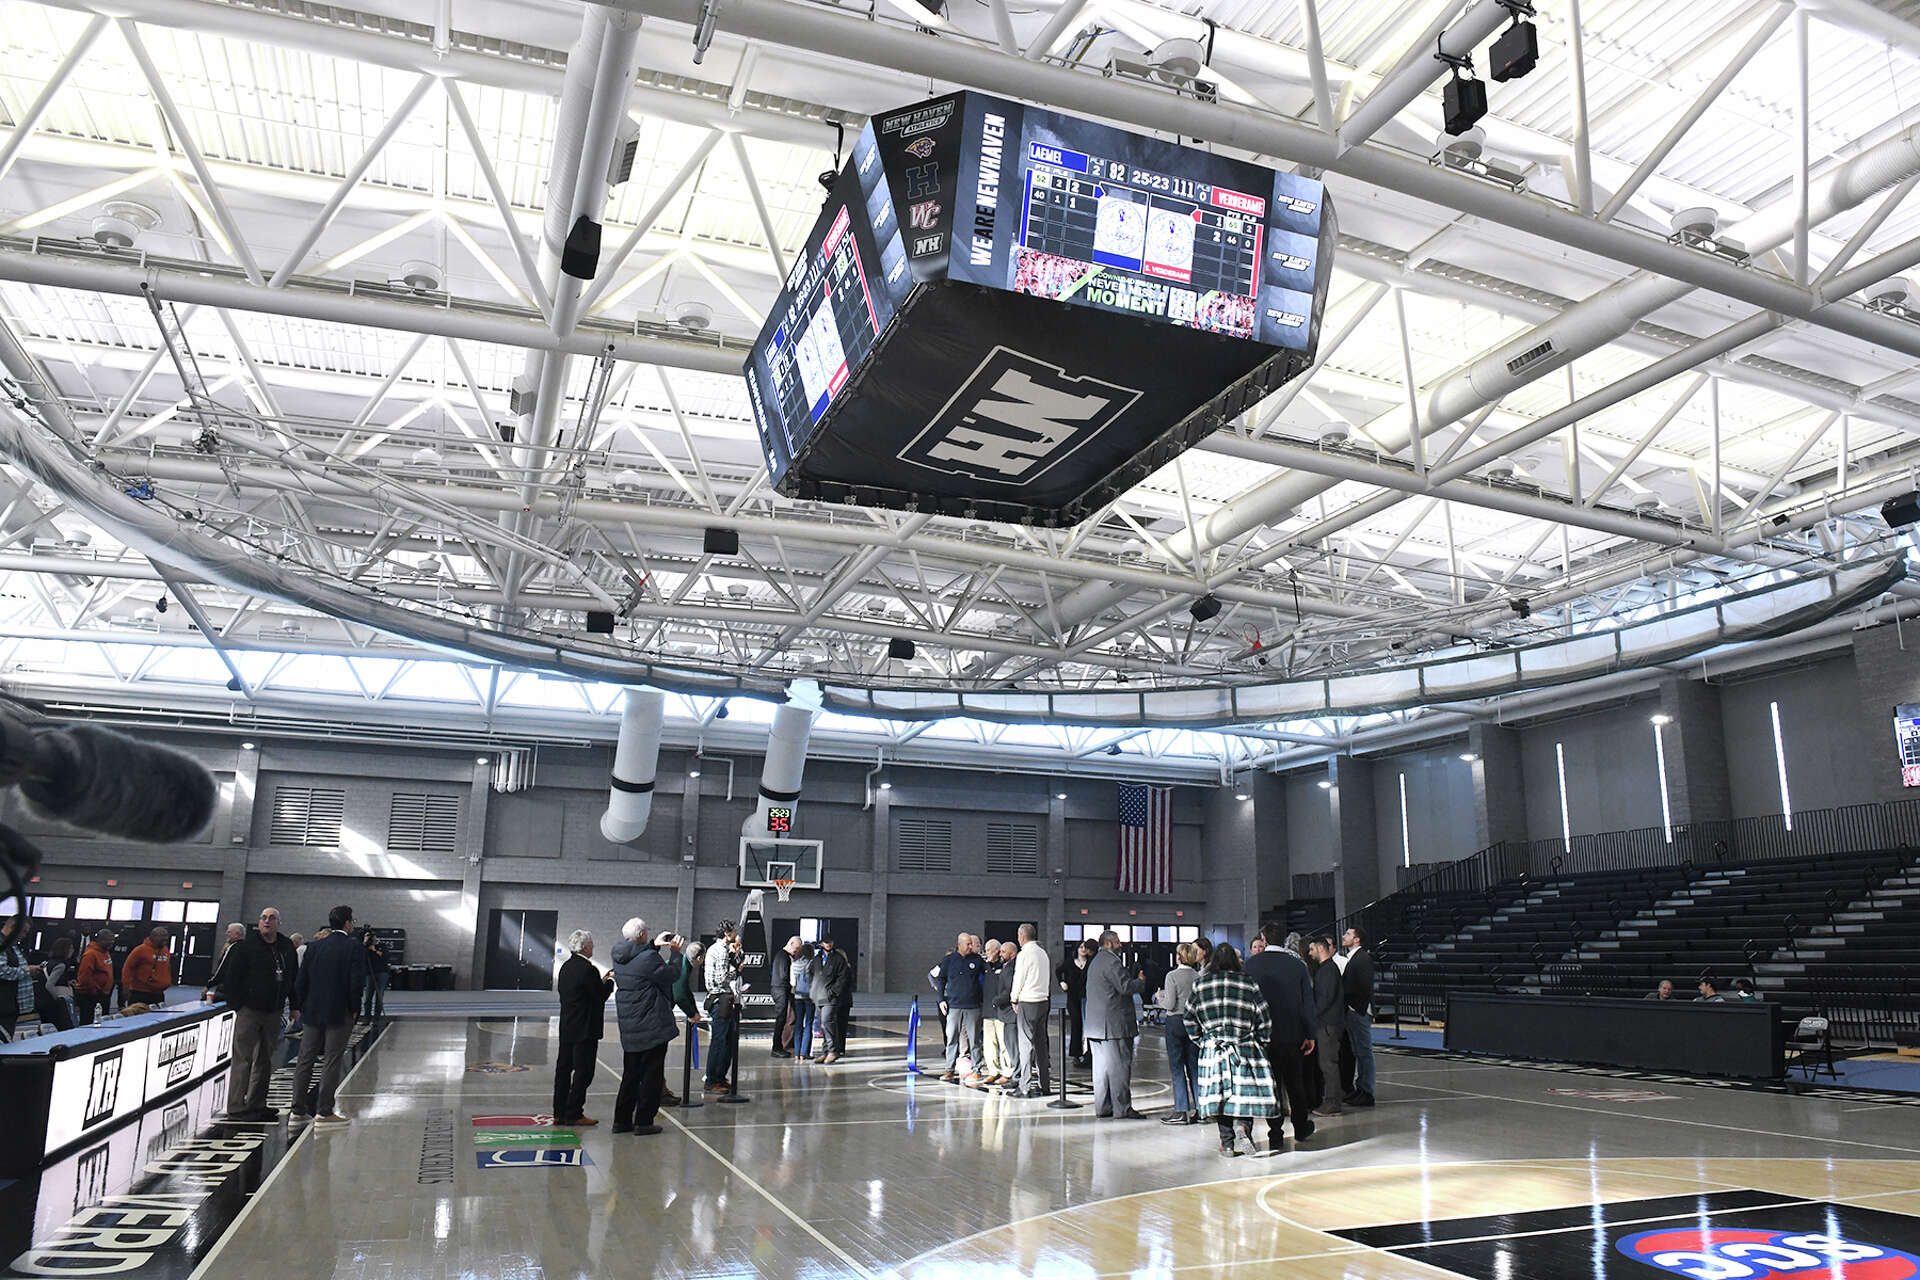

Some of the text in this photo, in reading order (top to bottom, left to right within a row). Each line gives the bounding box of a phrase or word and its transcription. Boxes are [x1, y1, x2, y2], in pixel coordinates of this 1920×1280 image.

[885, 103, 953, 131] NEW HAVEN
[1029, 144, 1064, 165] LAEMEL
[1056, 178, 1063, 188] 2
[1071, 182, 1080, 194] 2
[1132, 169, 1170, 191] 25:23
[1172, 178, 1195, 199] 111
[1033, 190, 1077, 209] 40 1 1
[1216, 216, 1222, 228] 1
[914, 235, 941, 256] NH
[1212, 231, 1221, 243] 2
[1087, 276, 1127, 293] NEVER
[1086, 285, 1167, 316] MOMENT
[744, 954, 762, 965] NH
[85, 1056, 121, 1122] NH
